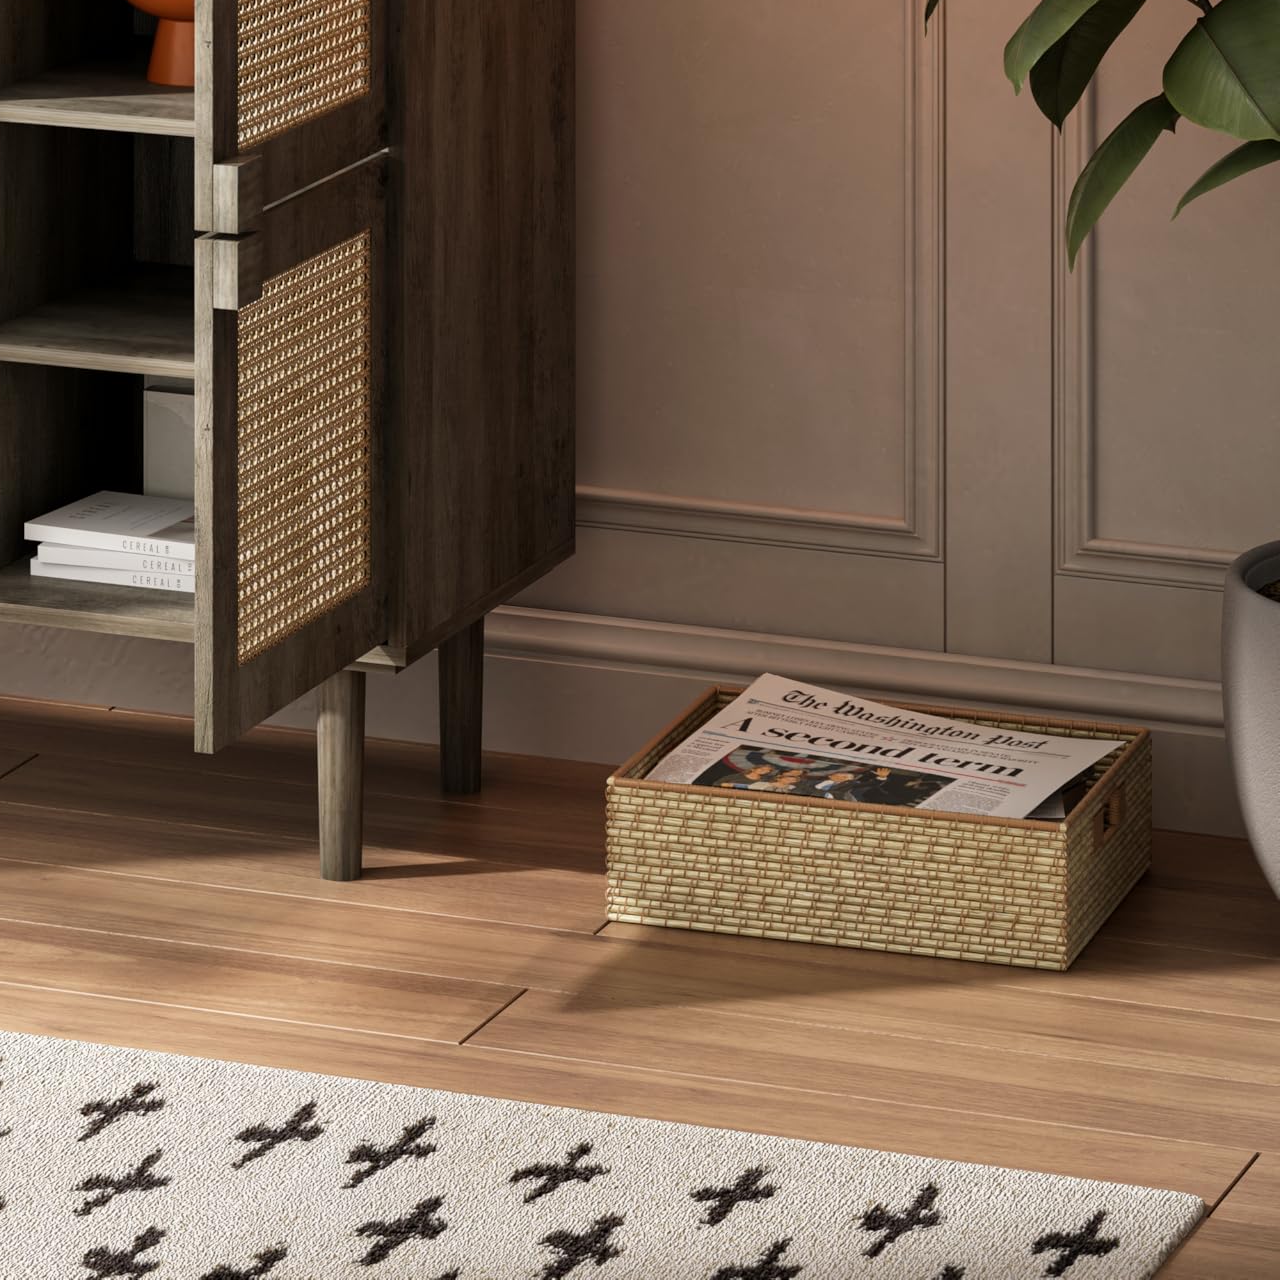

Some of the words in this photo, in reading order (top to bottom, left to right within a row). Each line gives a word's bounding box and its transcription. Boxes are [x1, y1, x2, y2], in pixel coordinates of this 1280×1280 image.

[122, 539, 160, 554] CEREAL
[142, 559, 182, 573] CEREAL
[132, 575, 171, 589] CEREAL
[781, 689, 828, 710] The
[832, 700, 980, 740] Washington
[981, 734, 1048, 750] Post
[721, 717, 753, 732] A
[761, 726, 917, 759] second
[918, 751, 1025, 778] term
